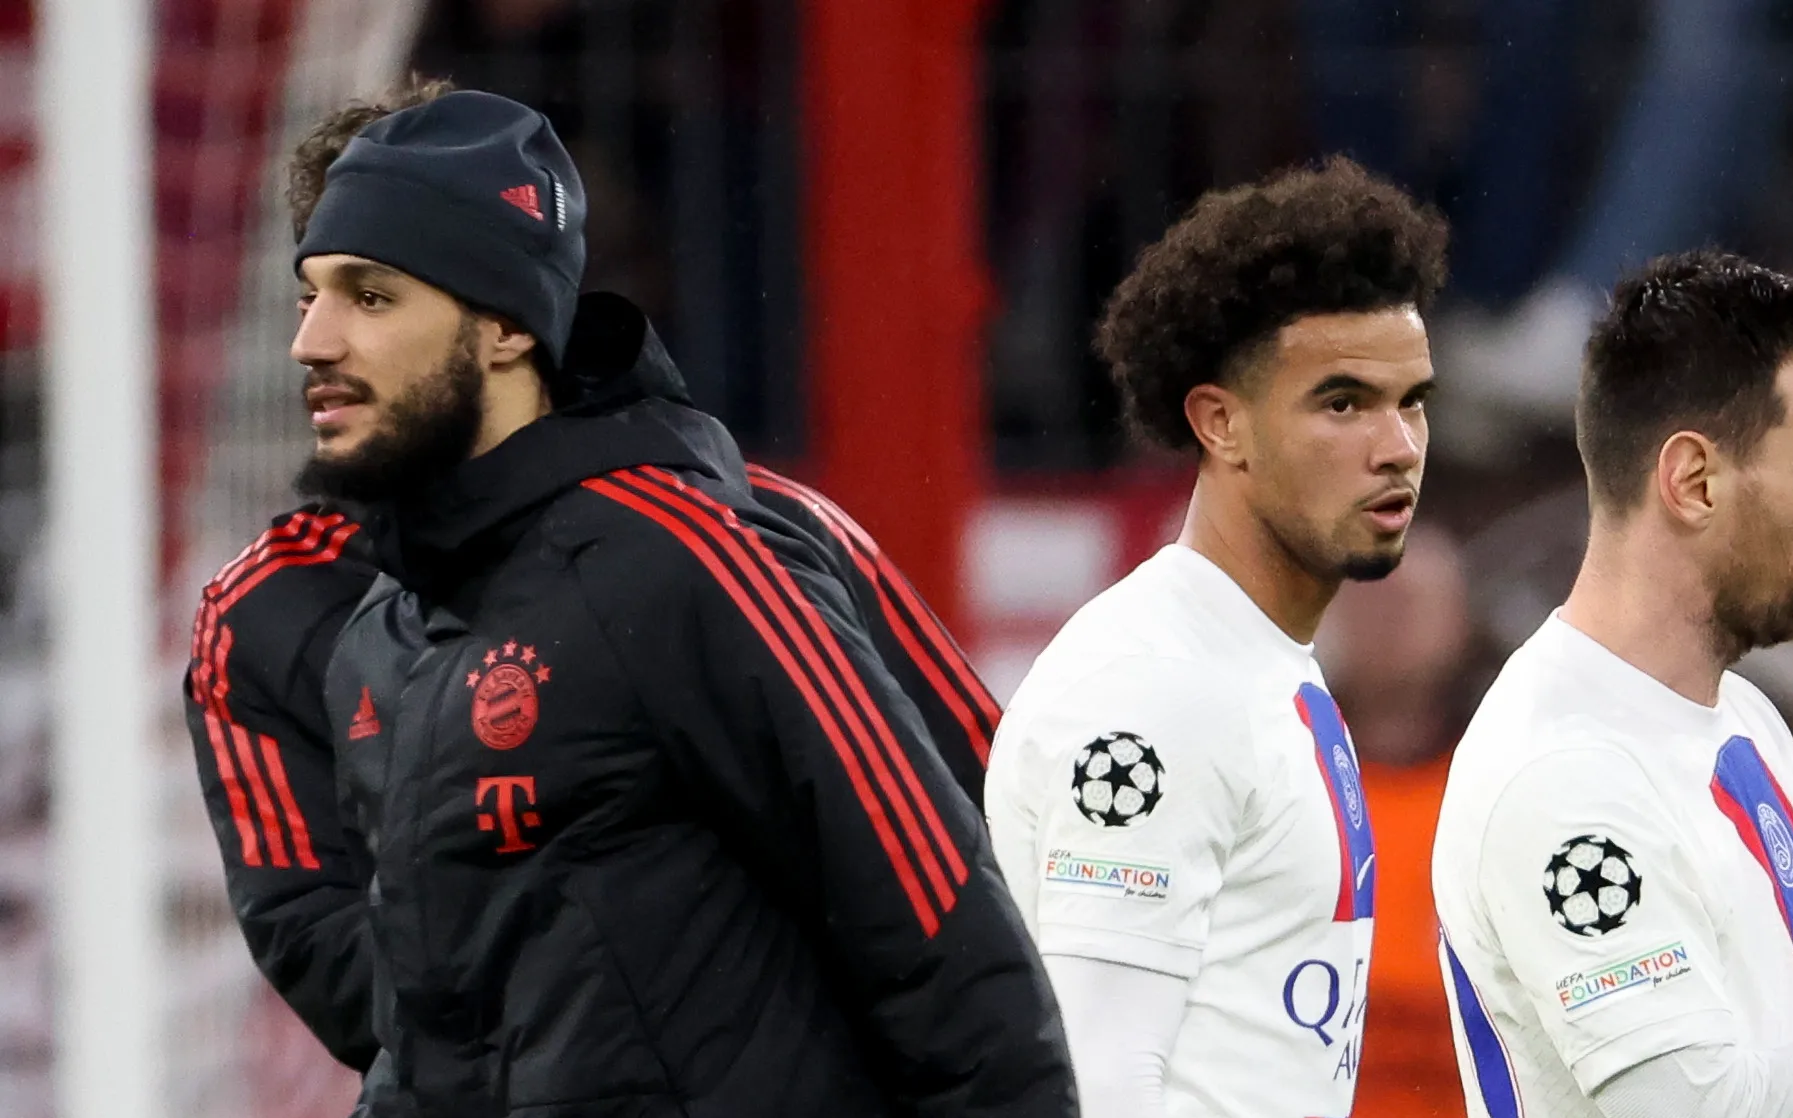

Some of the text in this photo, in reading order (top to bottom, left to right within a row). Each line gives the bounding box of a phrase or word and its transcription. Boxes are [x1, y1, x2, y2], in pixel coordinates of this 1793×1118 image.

[1046, 860, 1169, 888] FOUNDATION
[1555, 972, 1584, 990] UEFA
[1558, 946, 1688, 1006] FOUNDATION
